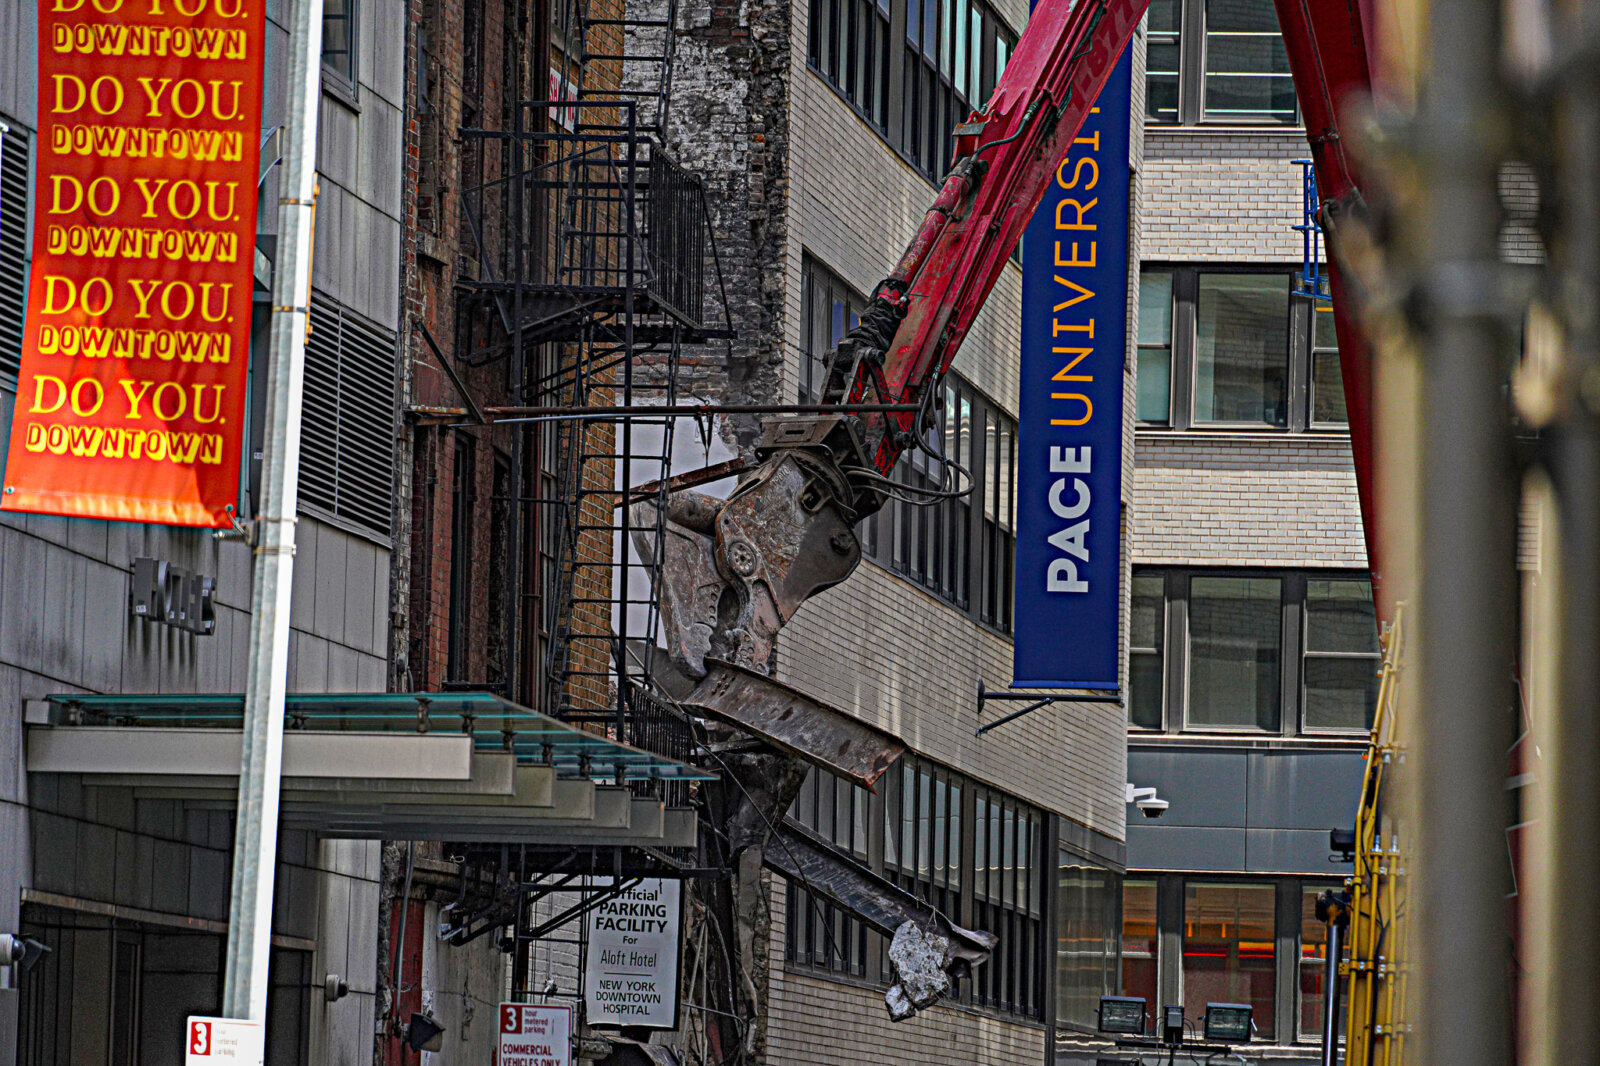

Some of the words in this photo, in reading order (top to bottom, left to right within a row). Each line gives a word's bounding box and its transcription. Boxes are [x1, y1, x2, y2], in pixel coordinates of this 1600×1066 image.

[52, 22, 247, 60] DOWNTOWN
[51, 74, 124, 115] DO
[137, 77, 244, 121] YOU.
[51, 124, 243, 162] DOWNTOWN
[48, 175, 120, 217] DO
[134, 178, 240, 222] YOU.
[47, 225, 238, 263] DOWNTOWN
[1051, 106, 1100, 426] UNIVERSI
[40, 275, 114, 317] DO
[128, 279, 234, 323] YOU.
[37, 324, 231, 364] DOWNTOWN
[28, 374, 104, 418] DO
[118, 379, 226, 424] YOU.
[25, 422, 223, 465] DOWNTOWN
[1046, 445, 1092, 594] PACE
[599, 902, 667, 918] PARKING
[595, 917, 668, 934] FACILITY
[622, 935, 639, 945] For
[600, 949, 627, 966] Aloft
[629, 951, 657, 968] Hotel
[595, 991, 661, 1004] DOWNTOWN
[599, 980, 623, 991] NEW
[626, 981, 656, 992] YORK
[505, 1006, 517, 1032] 3
[524, 1009, 538, 1017] hour
[603, 1003, 650, 1016] HOSPITAL
[194, 1022, 207, 1054] 3
[524, 1026, 546, 1036] parking
[503, 1043, 553, 1056] COMMERCIAL
[503, 1057, 539, 1066] VEHICLES
[540, 1058, 561, 1066] ONLY
